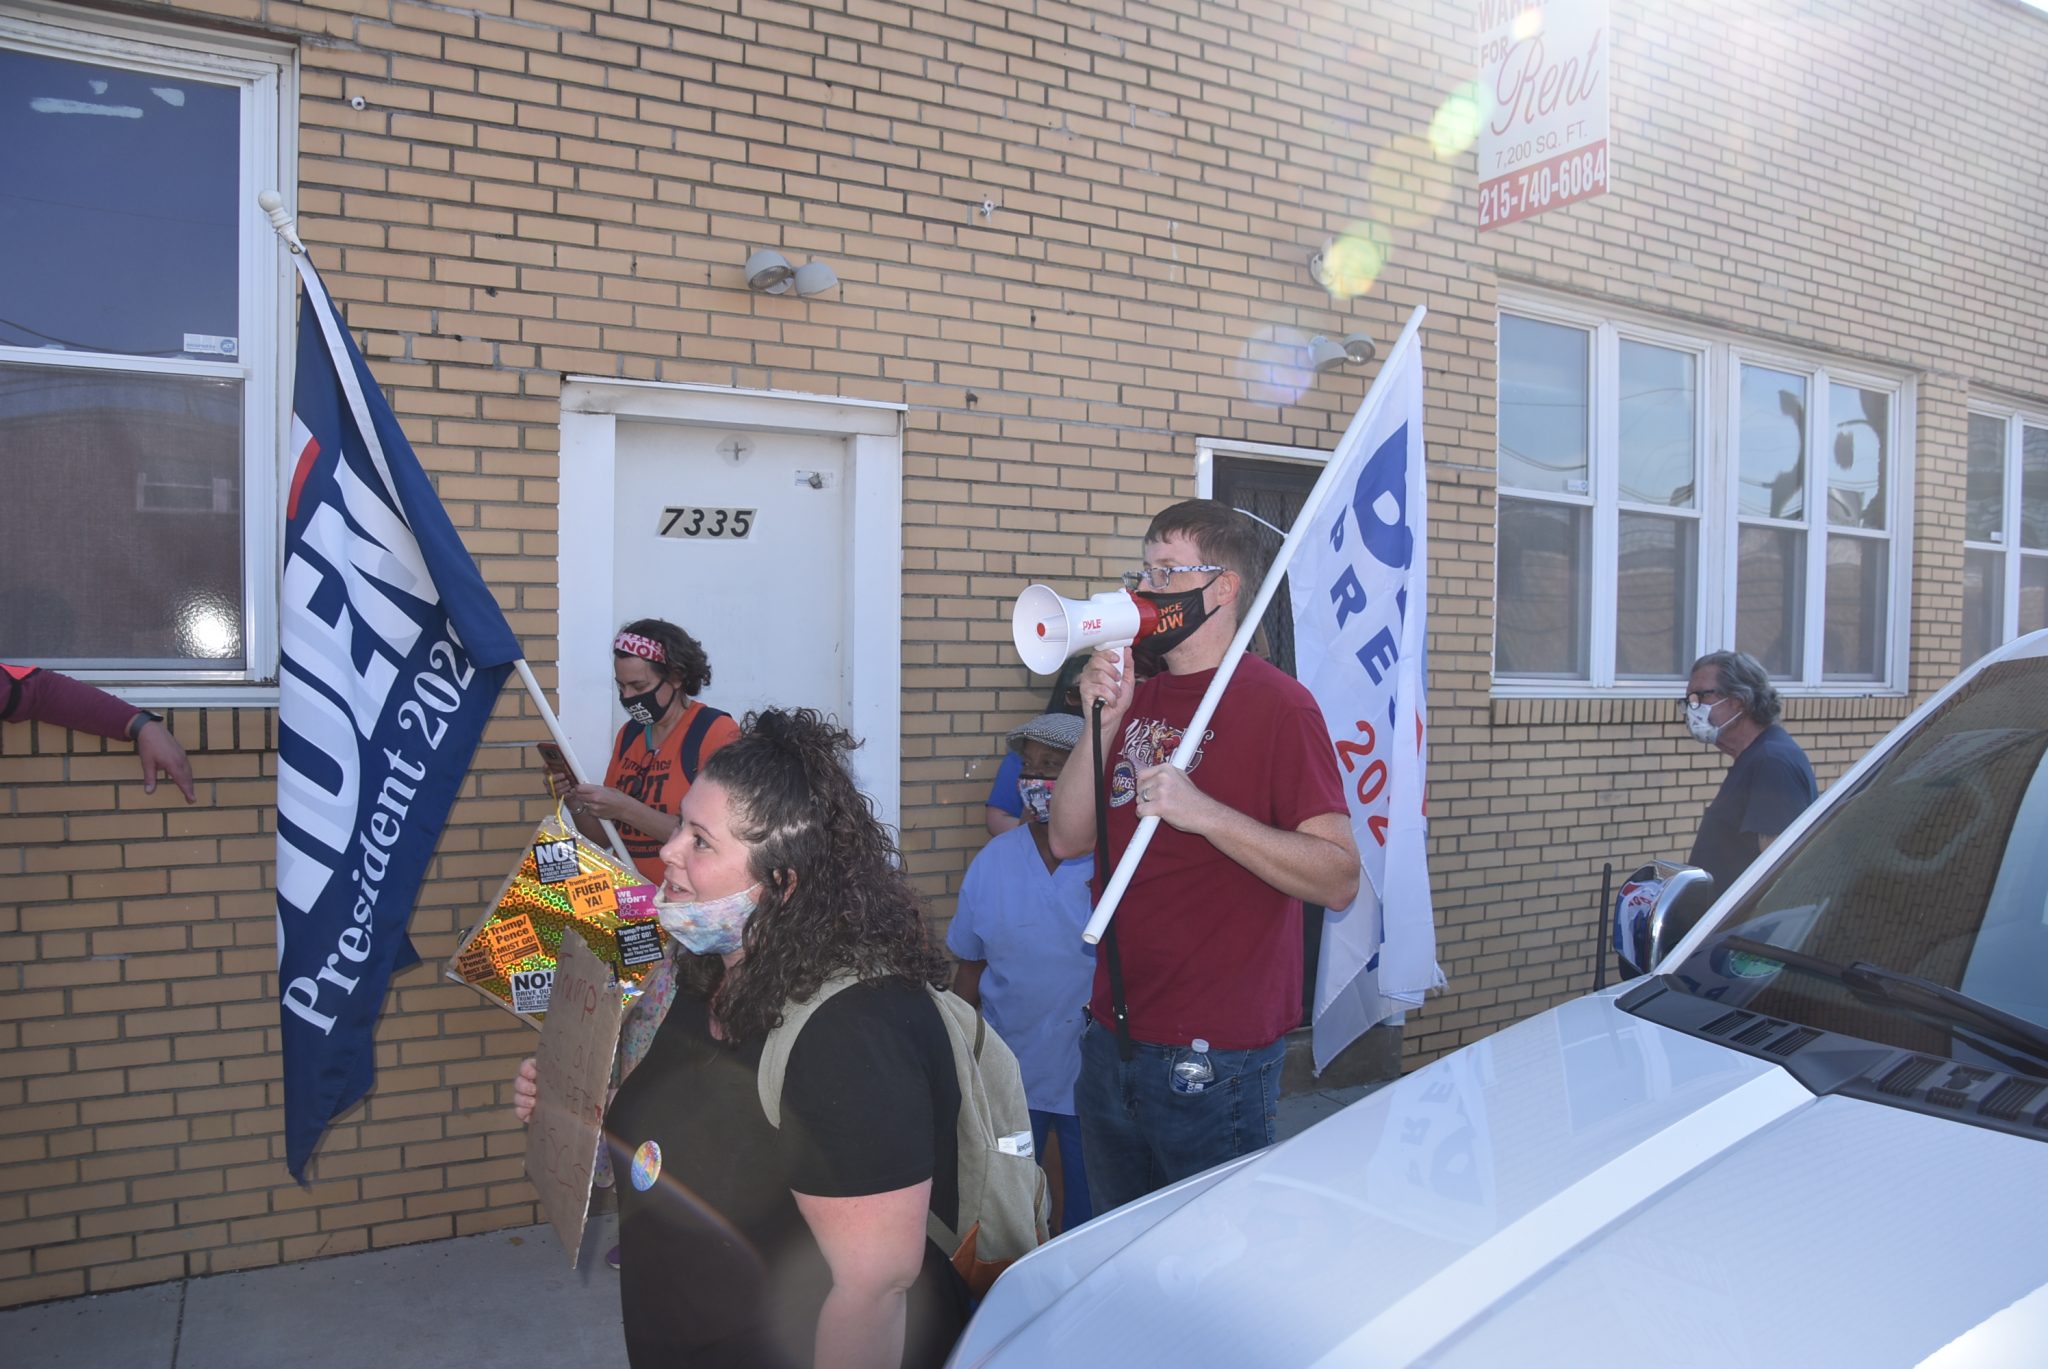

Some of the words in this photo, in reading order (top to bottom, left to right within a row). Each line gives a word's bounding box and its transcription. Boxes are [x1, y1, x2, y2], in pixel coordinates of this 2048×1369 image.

[1481, 36, 1509, 68] FOR
[1491, 28, 1602, 136] Rent
[1496, 140, 1532, 168] 7,200
[1536, 131, 1560, 154] SQ.
[1567, 120, 1588, 143] FT.
[1480, 147, 1606, 226] 215-740-6084
[660, 508, 753, 538] 7335
[1159, 601, 1183, 617] NCE
[1082, 618, 1102, 631] PYLE
[1153, 612, 1184, 636] OW
[276, 449, 440, 960] IDEN
[281, 746, 427, 1036] President
[397, 617, 478, 751] 202
[535, 840, 576, 865] NO!
[584, 894, 604, 908] YA!
[616, 890, 631, 898] WE
[489, 914, 527, 935] Trump/
[495, 926, 530, 945] Pence
[496, 940, 521, 955] MUST
[522, 934, 537, 945] GO!
[624, 933, 640, 943] MUST
[463, 957, 488, 969] Pence
[513, 971, 553, 991] NO!
[515, 989, 537, 997] DRIVE
